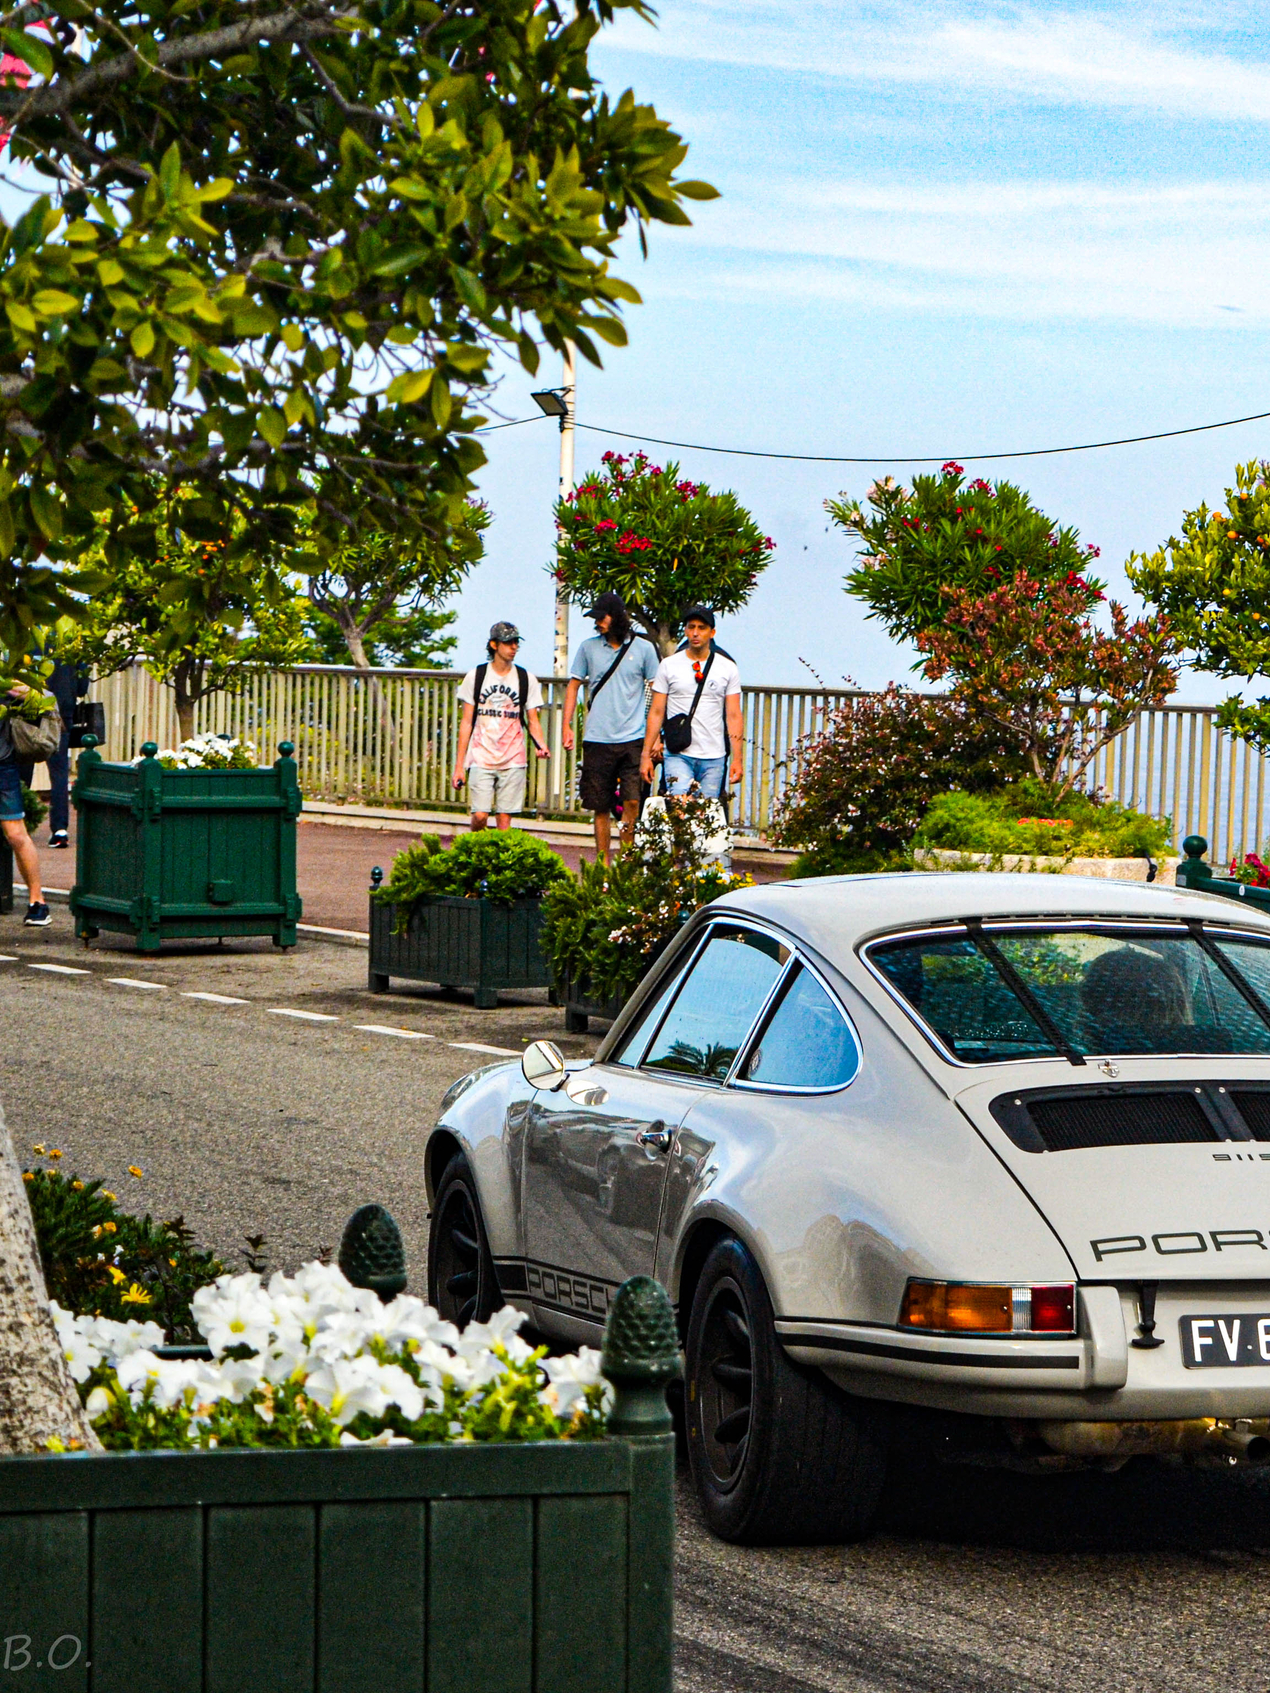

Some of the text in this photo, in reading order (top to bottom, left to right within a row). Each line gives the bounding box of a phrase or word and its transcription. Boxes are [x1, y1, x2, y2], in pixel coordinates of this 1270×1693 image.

[478, 709, 502, 718] CLASSIC
[527, 1265, 611, 1315] PORSC
[1191, 1319, 1240, 1362] FV
